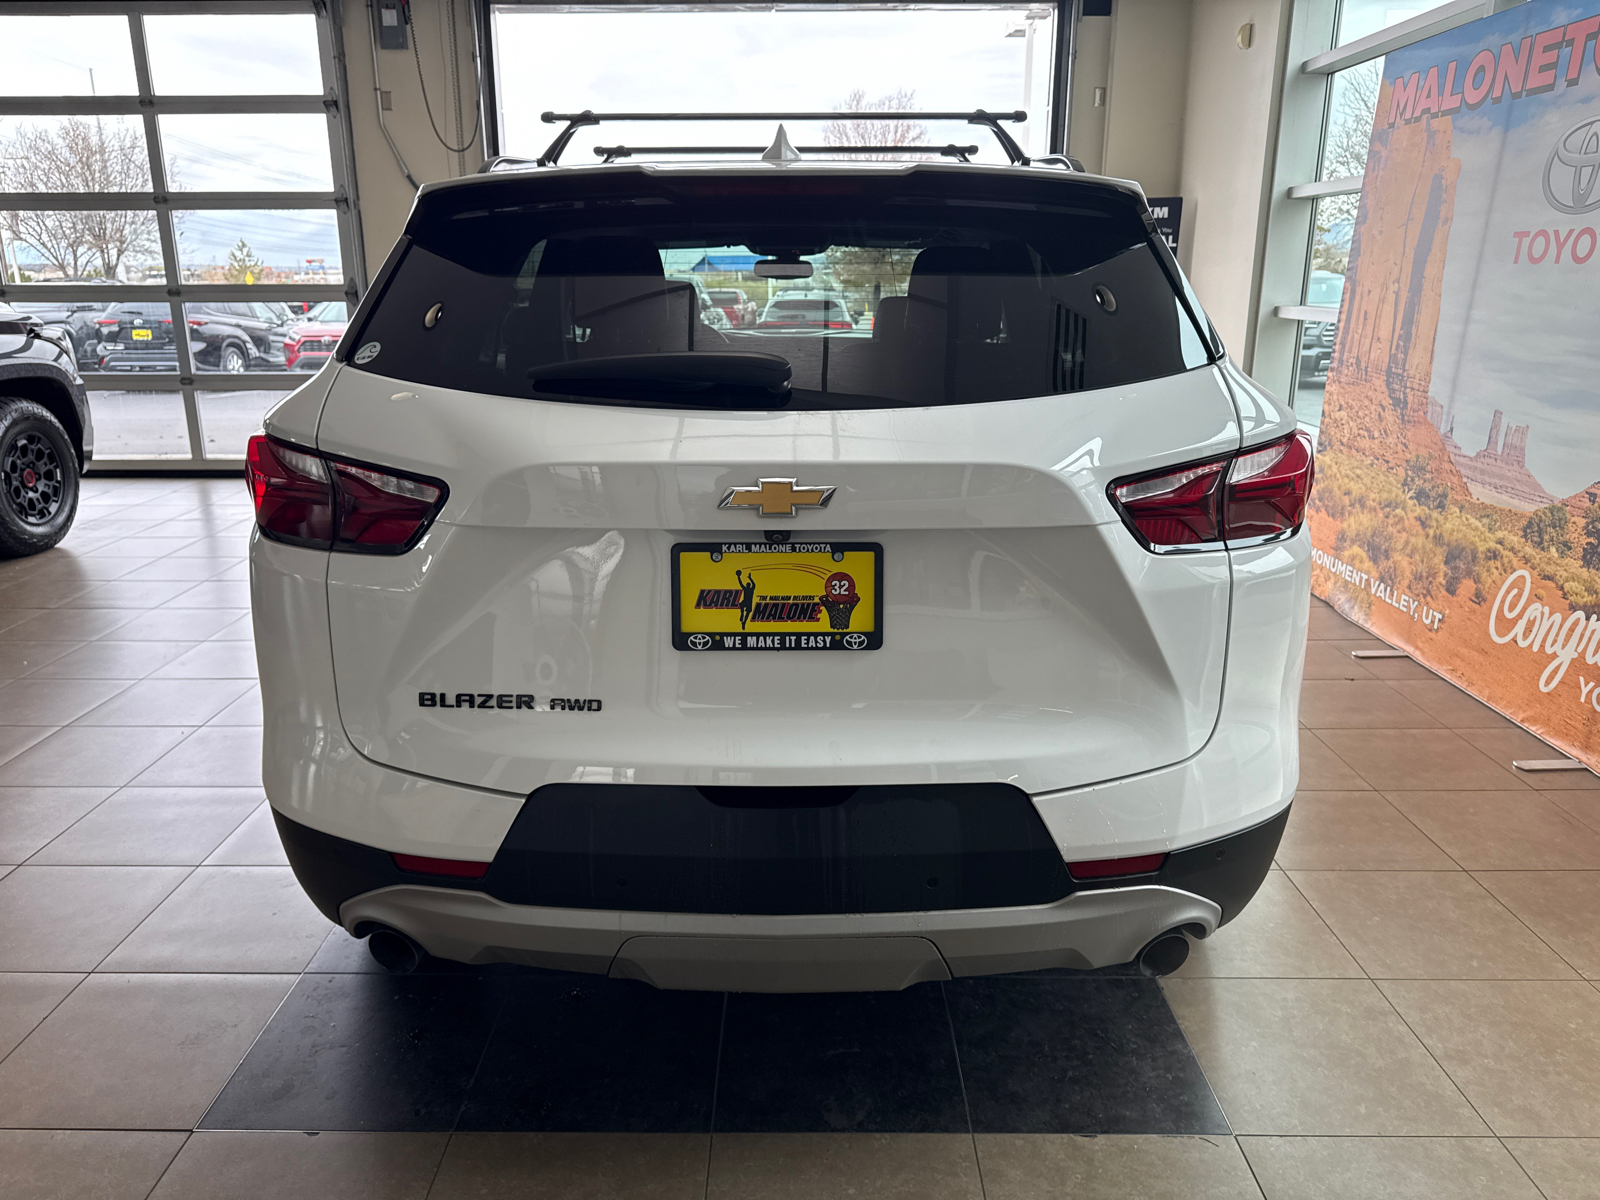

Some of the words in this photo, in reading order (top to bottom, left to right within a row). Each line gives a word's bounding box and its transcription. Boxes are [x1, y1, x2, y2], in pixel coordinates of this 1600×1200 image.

[1387, 13, 1600, 129] MALONET
[722, 544, 748, 553] KARL
[751, 544, 792, 553] MALONE
[794, 544, 832, 553] TOYOTA
[831, 580, 849, 595] 32
[1310, 547, 1368, 589] MONUMENT
[1370, 577, 1418, 622] VALLEY,
[1422, 605, 1443, 630] UT
[695, 588, 743, 609] KARL
[751, 602, 823, 622] MALONE
[723, 636, 742, 648] WE
[747, 636, 781, 648] MAKE
[785, 636, 796, 648] IT
[801, 636, 832, 648] EASY
[418, 692, 535, 709] BLAZER
[549, 698, 602, 712] AWD
